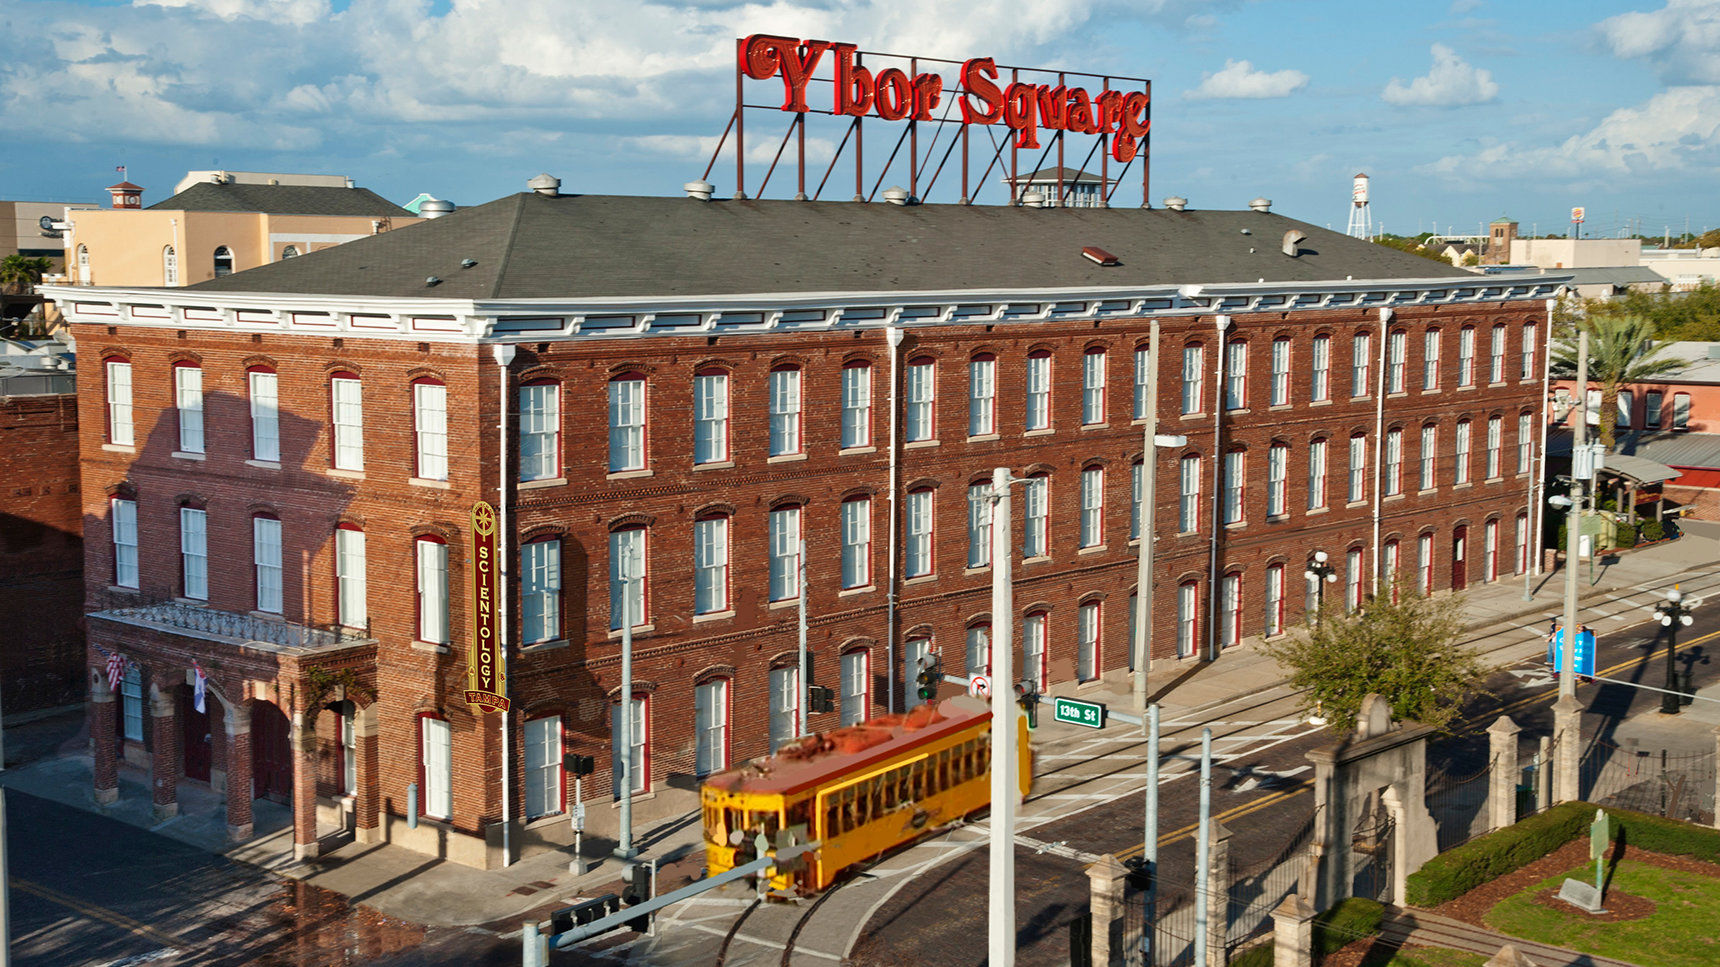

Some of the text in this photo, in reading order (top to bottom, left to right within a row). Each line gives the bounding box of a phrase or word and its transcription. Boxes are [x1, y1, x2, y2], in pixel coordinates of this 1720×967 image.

[740, 34, 1151, 163] Ybor Square
[479, 546, 491, 688] SCIENTOLOGY
[468, 692, 506, 709] TAMPA
[1060, 705, 1096, 721] 13th St
